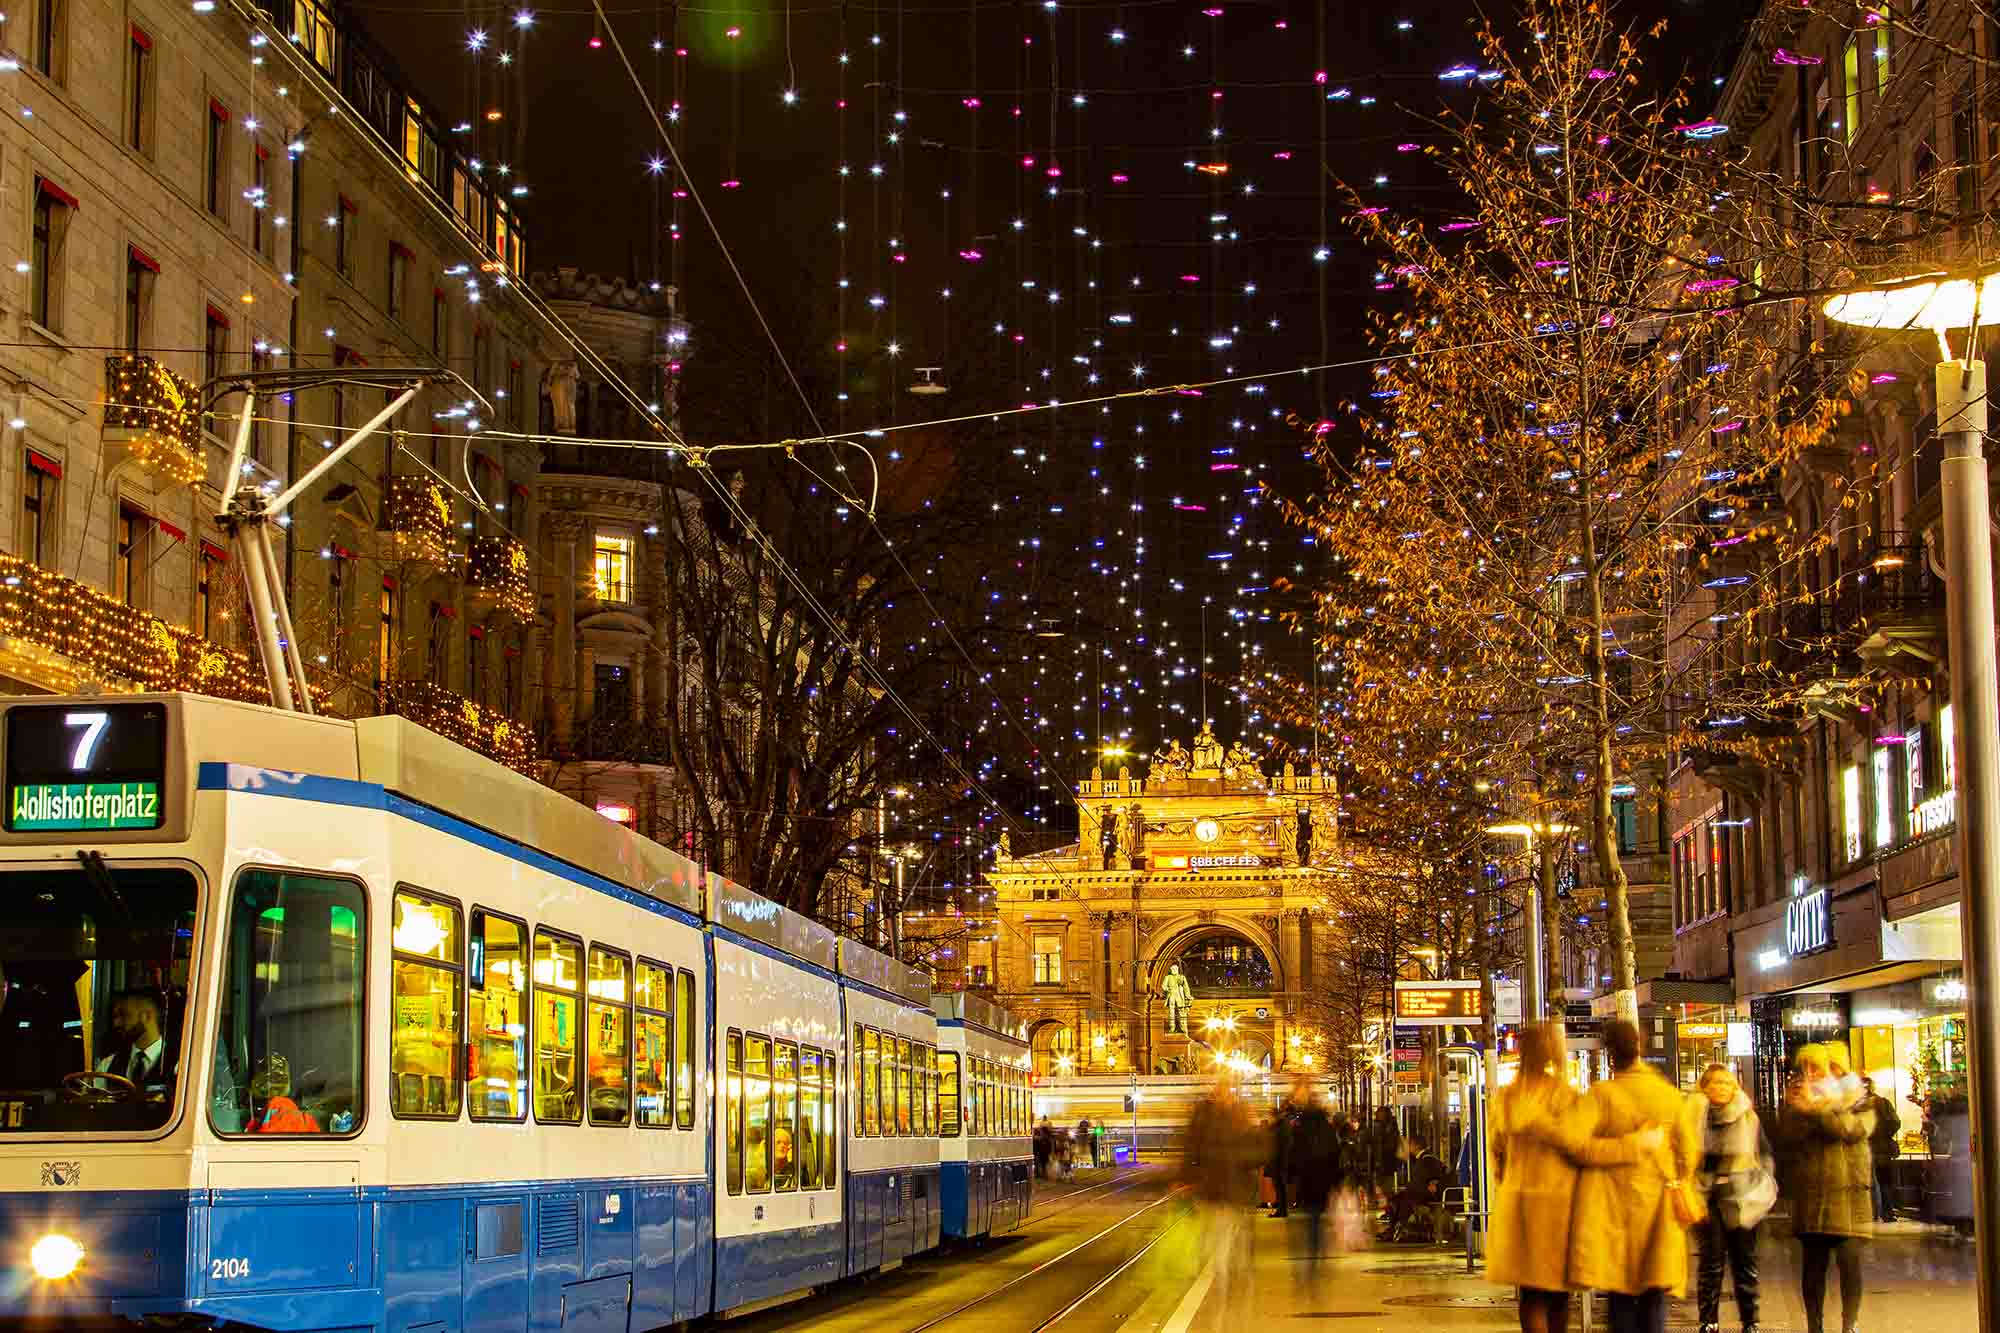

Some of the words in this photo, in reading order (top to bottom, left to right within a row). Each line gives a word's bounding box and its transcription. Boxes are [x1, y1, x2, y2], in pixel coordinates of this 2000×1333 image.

[65, 712, 109, 769] 7
[14, 784, 156, 826] Wollishoferplatz
[1190, 856, 1212, 867] SBB
[211, 1257, 250, 1279] 2104
